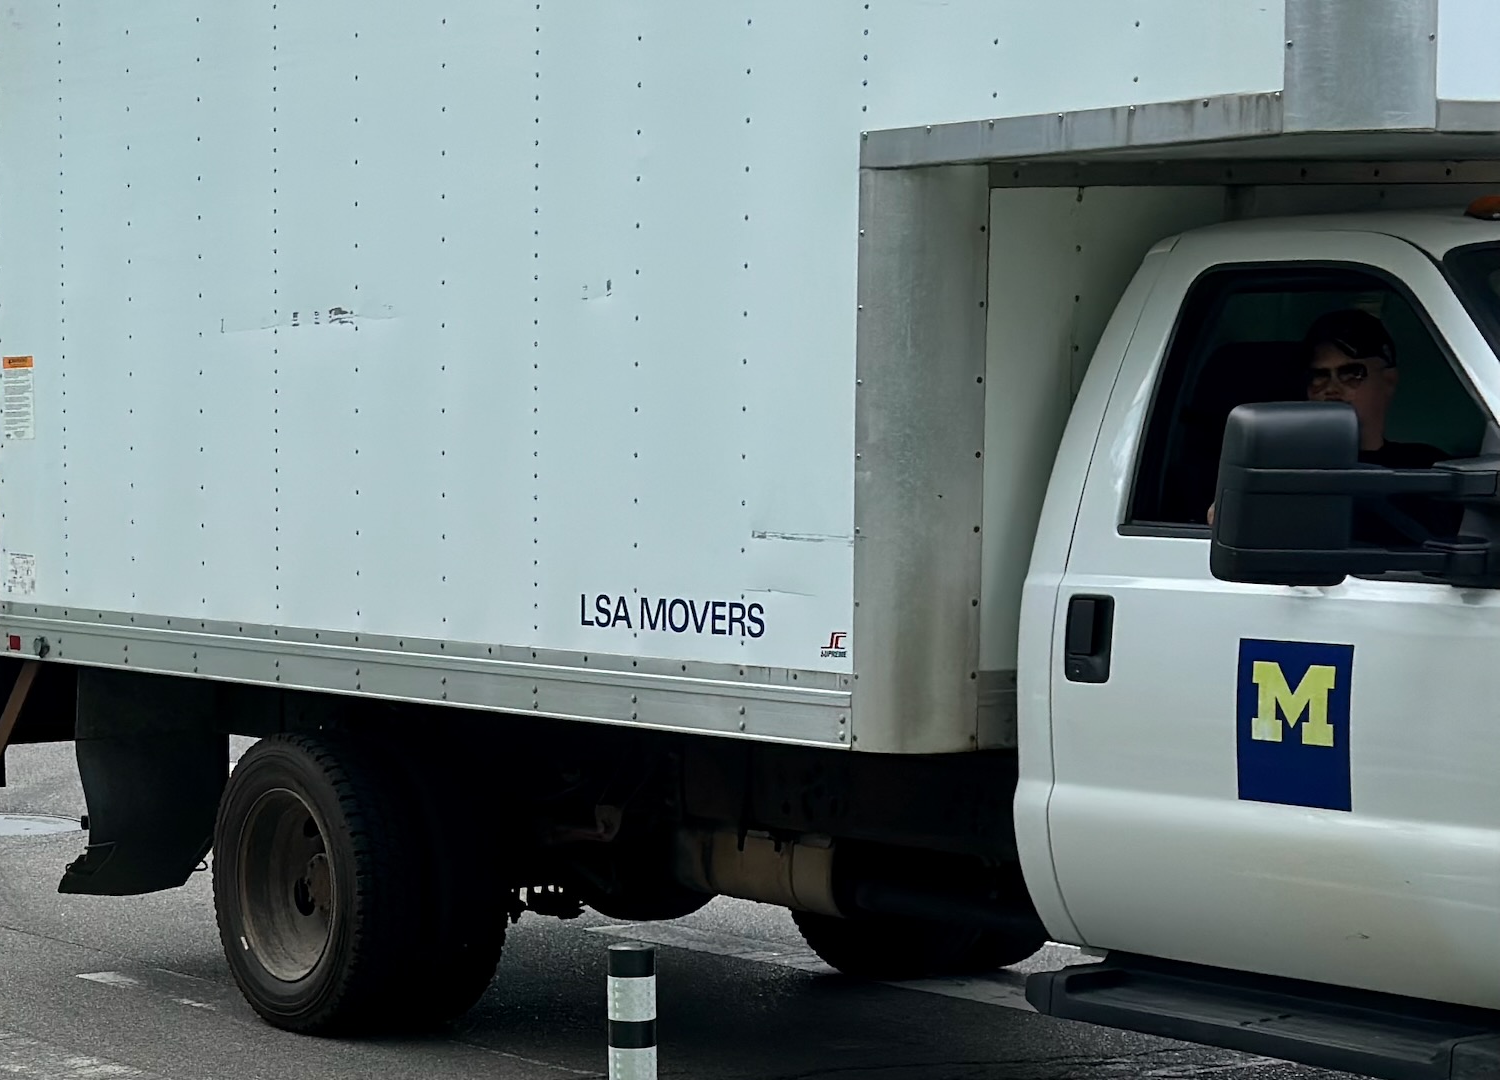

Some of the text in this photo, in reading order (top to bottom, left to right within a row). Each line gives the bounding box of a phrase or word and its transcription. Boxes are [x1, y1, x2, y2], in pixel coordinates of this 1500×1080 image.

[580, 593, 765, 638] LSA MOVERS
[1251, 660, 1336, 747] M
